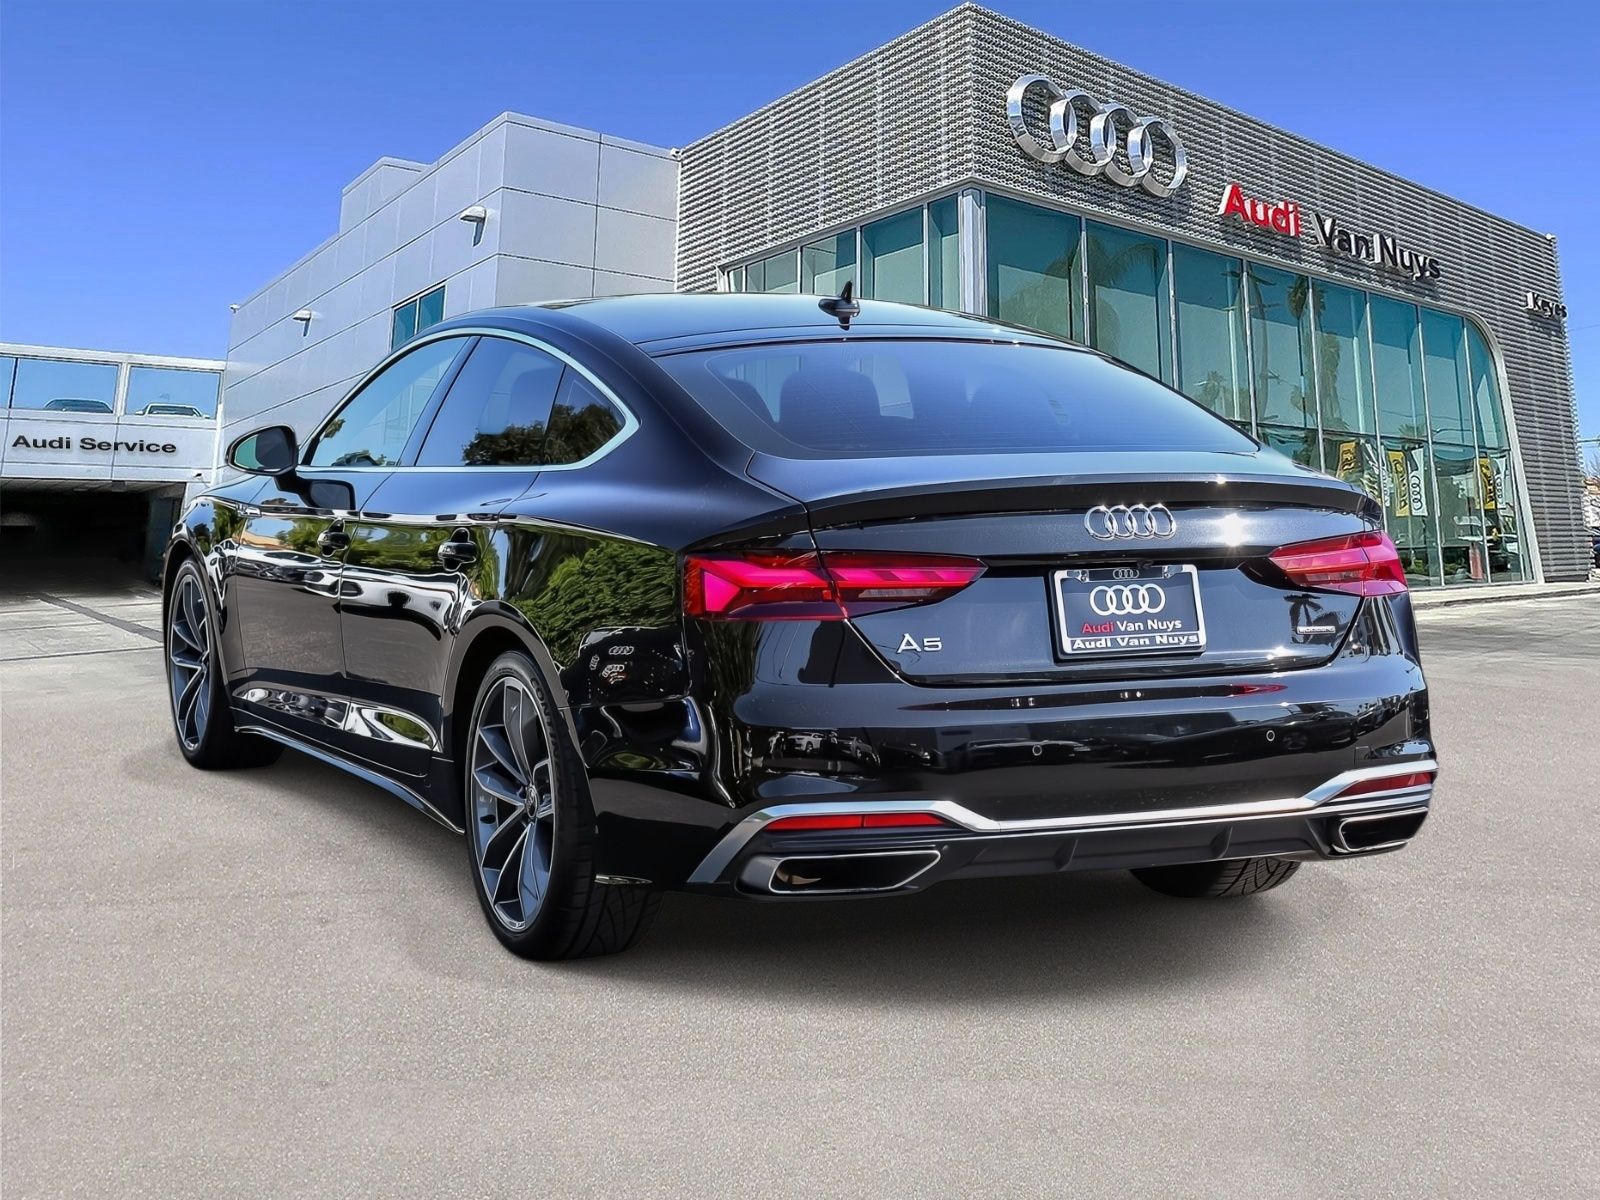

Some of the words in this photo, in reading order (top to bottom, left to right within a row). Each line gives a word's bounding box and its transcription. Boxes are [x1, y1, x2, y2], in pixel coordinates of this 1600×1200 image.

[1218, 183, 1301, 237] Audi
[1310, 213, 1371, 258] Van
[1373, 233, 1440, 281] Nuys
[1527, 292, 1568, 318] Keyes
[12, 435, 71, 449] Audi
[79, 437, 177, 453] Service
[1082, 621, 1114, 633] Audi
[1116, 620, 1143, 632] Van
[1147, 619, 1181, 632] Nuys
[896, 633, 942, 654] A5
[1072, 638, 1111, 649] Audi
[1114, 636, 1149, 646] Van
[1155, 633, 1198, 645] Nuys
